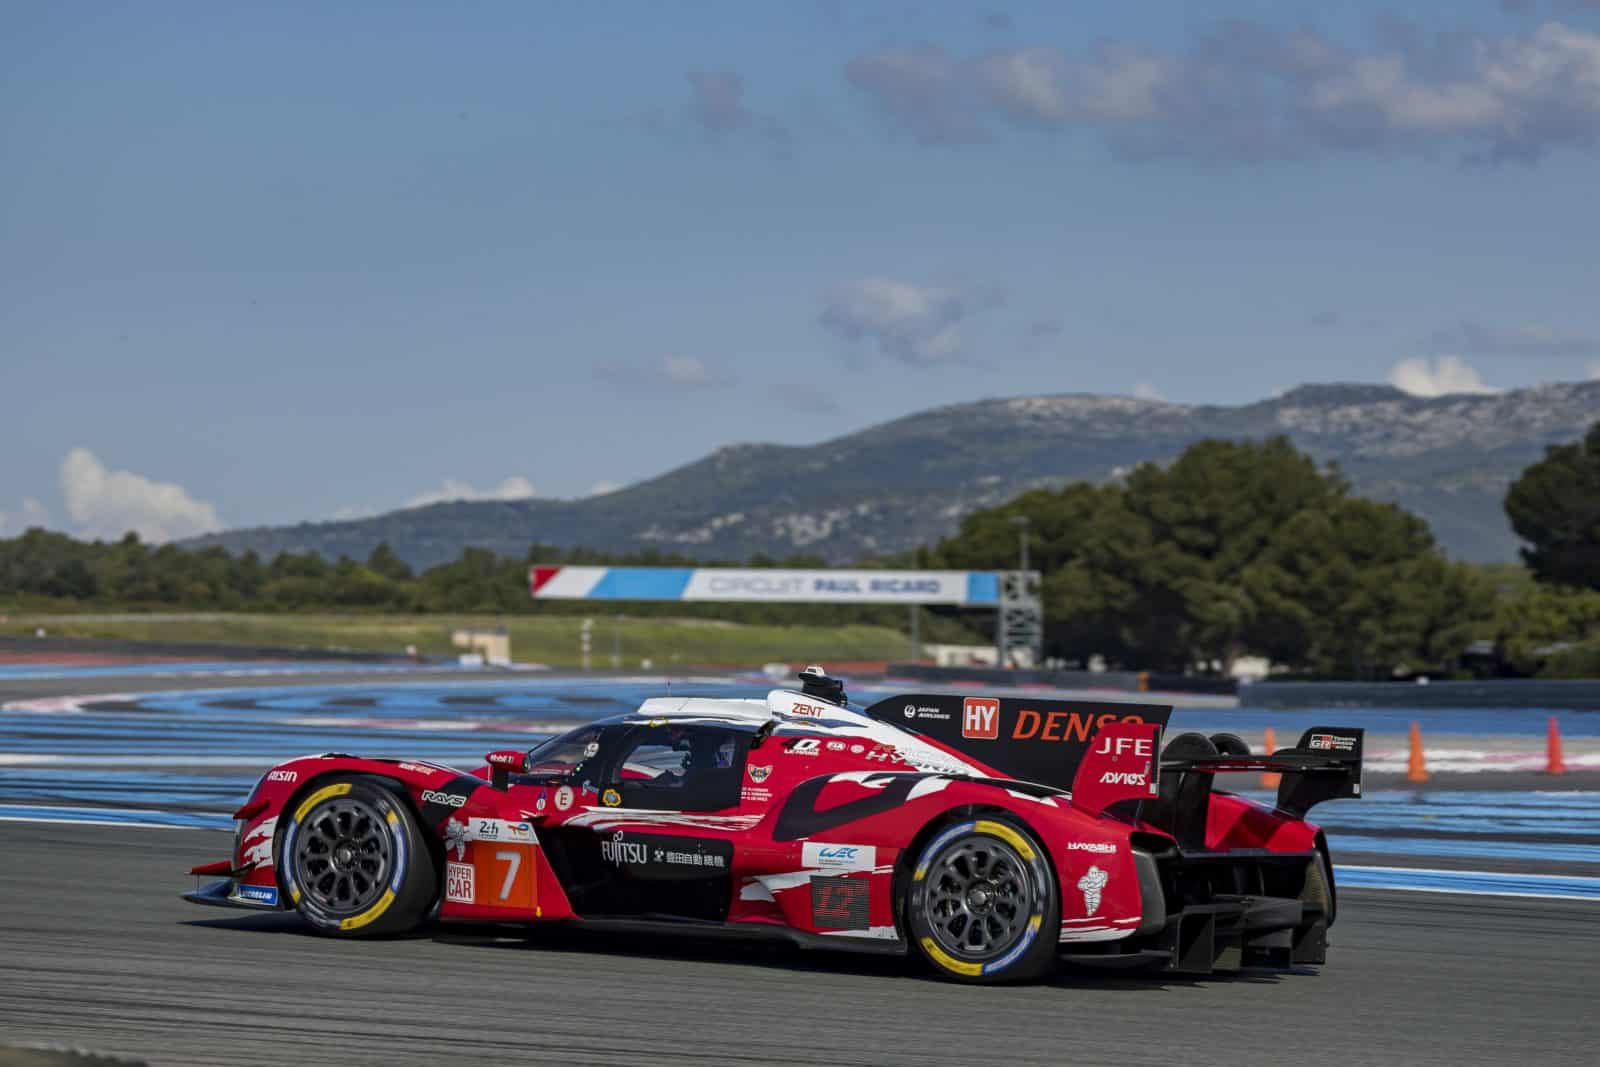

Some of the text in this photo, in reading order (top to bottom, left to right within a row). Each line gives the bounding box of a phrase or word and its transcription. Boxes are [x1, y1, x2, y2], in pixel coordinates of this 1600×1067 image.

[812, 577, 862, 594] PAUL
[868, 578, 941, 594] RICARD
[792, 702, 825, 717] ZENT
[966, 703, 997, 732] HY
[1011, 708, 1145, 743] DEN
[1095, 737, 1153, 757] JFE
[421, 790, 467, 807] RAYS
[560, 792, 568, 806] E
[601, 830, 648, 868] FUJITSU
[819, 847, 859, 859] WEC
[448, 865, 472, 881] HYPER
[496, 851, 521, 900] 7
[448, 879, 472, 899] CAR
